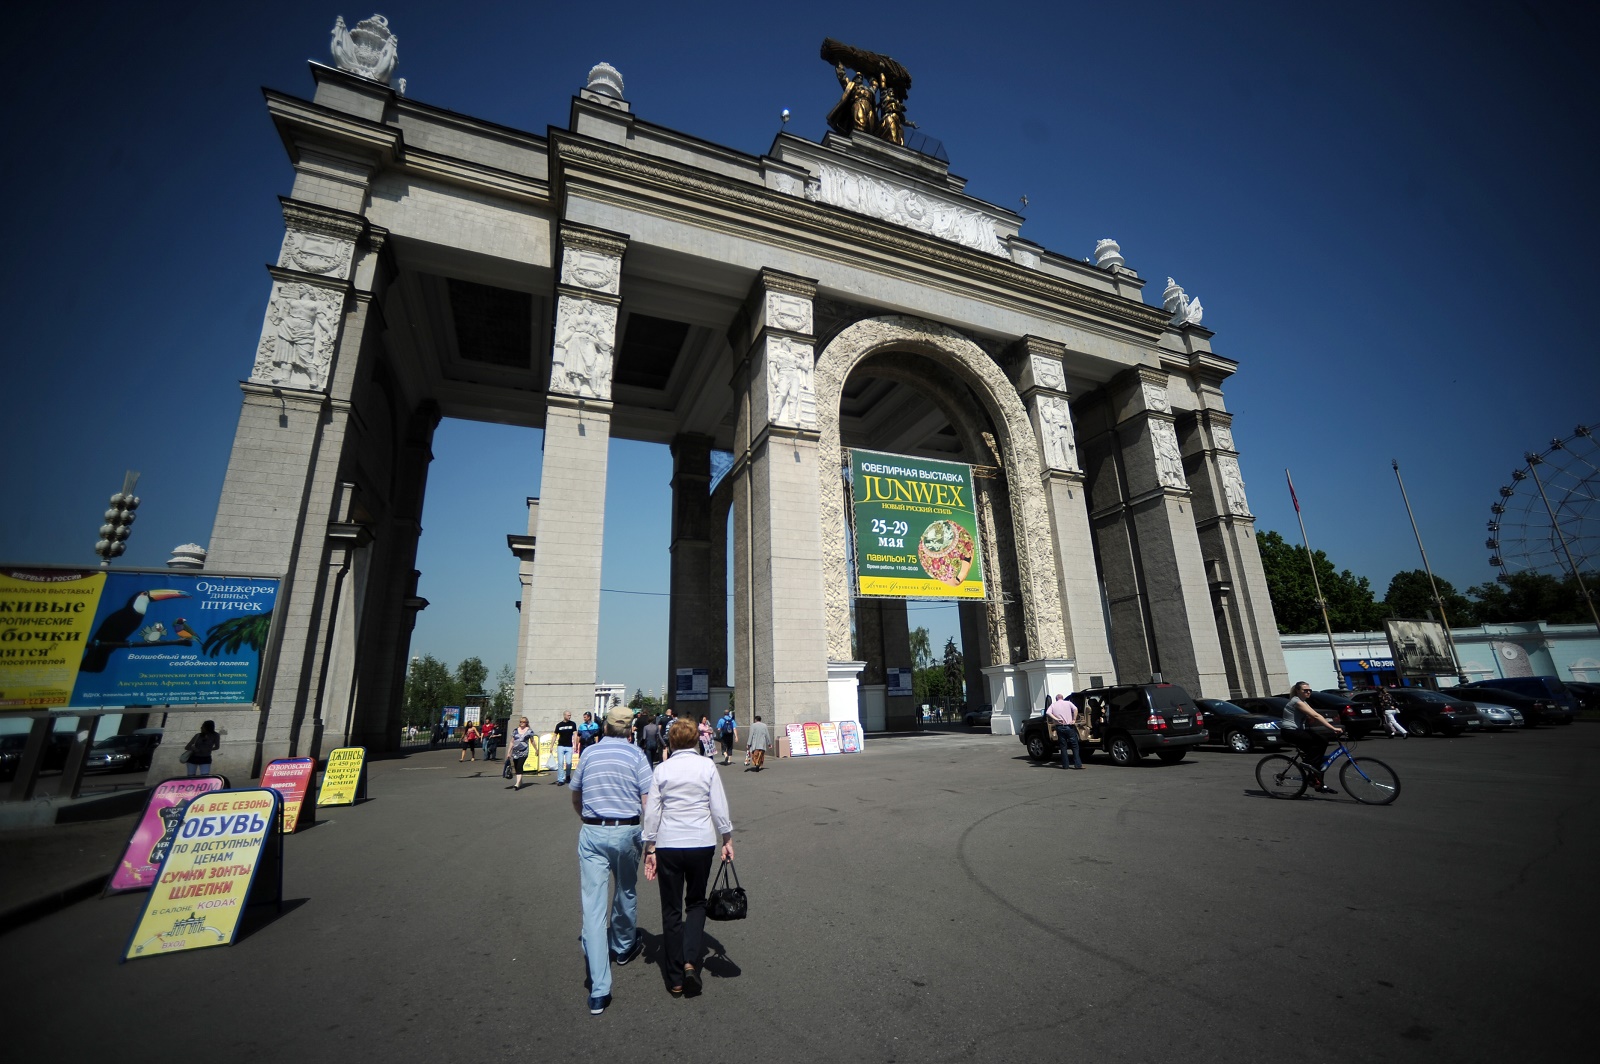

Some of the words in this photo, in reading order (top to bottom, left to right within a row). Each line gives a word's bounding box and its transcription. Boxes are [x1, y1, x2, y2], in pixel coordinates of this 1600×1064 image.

[861, 462, 918, 477] ЮВЕЛИРНАЯ
[919, 469, 964, 483] ВЫСТАВКА
[862, 475, 966, 508] JUNWEX
[881, 502, 906, 512] НОВЫЙ
[905, 505, 933, 513] РУССКИЙ
[933, 507, 953, 515] СТИЛЬ
[878, 536, 904, 548] мая
[866, 553, 906, 563] павильон
[906, 555, 917, 564] 75
[11, 572, 46, 582] ВПЕРВЫЕ
[52, 574, 82, 582] РОССИИ
[196, 581, 275, 596] Оранжерея
[200, 600, 263, 611] птичек
[127, 653, 179, 661] Волшебный
[331, 750, 364, 761] ДЖИНСЫ
[272, 769, 304, 777] КОНФЕТЫ
[158, 782, 219, 794] ПАРФЮМ
[190, 803, 205, 813] НА
[208, 801, 229, 812] ВСЕ
[232, 799, 272, 811] СЕЗОНЫ
[182, 813, 265, 839] ОБУВЬ
[172, 843, 189, 854] ПО
[190, 837, 262, 854] ДОСТУПНЫМ
[193, 851, 234, 865] ЦЕНАМ
[160, 868, 206, 884] СУМКИ
[208, 864, 252, 879] ЗОНТЫ
[168, 880, 233, 900] ШЛЕПКИ
[159, 904, 193, 915] САЛОНЕ
[197, 898, 237, 910] KODAK
[161, 939, 186, 950] ВХОД
